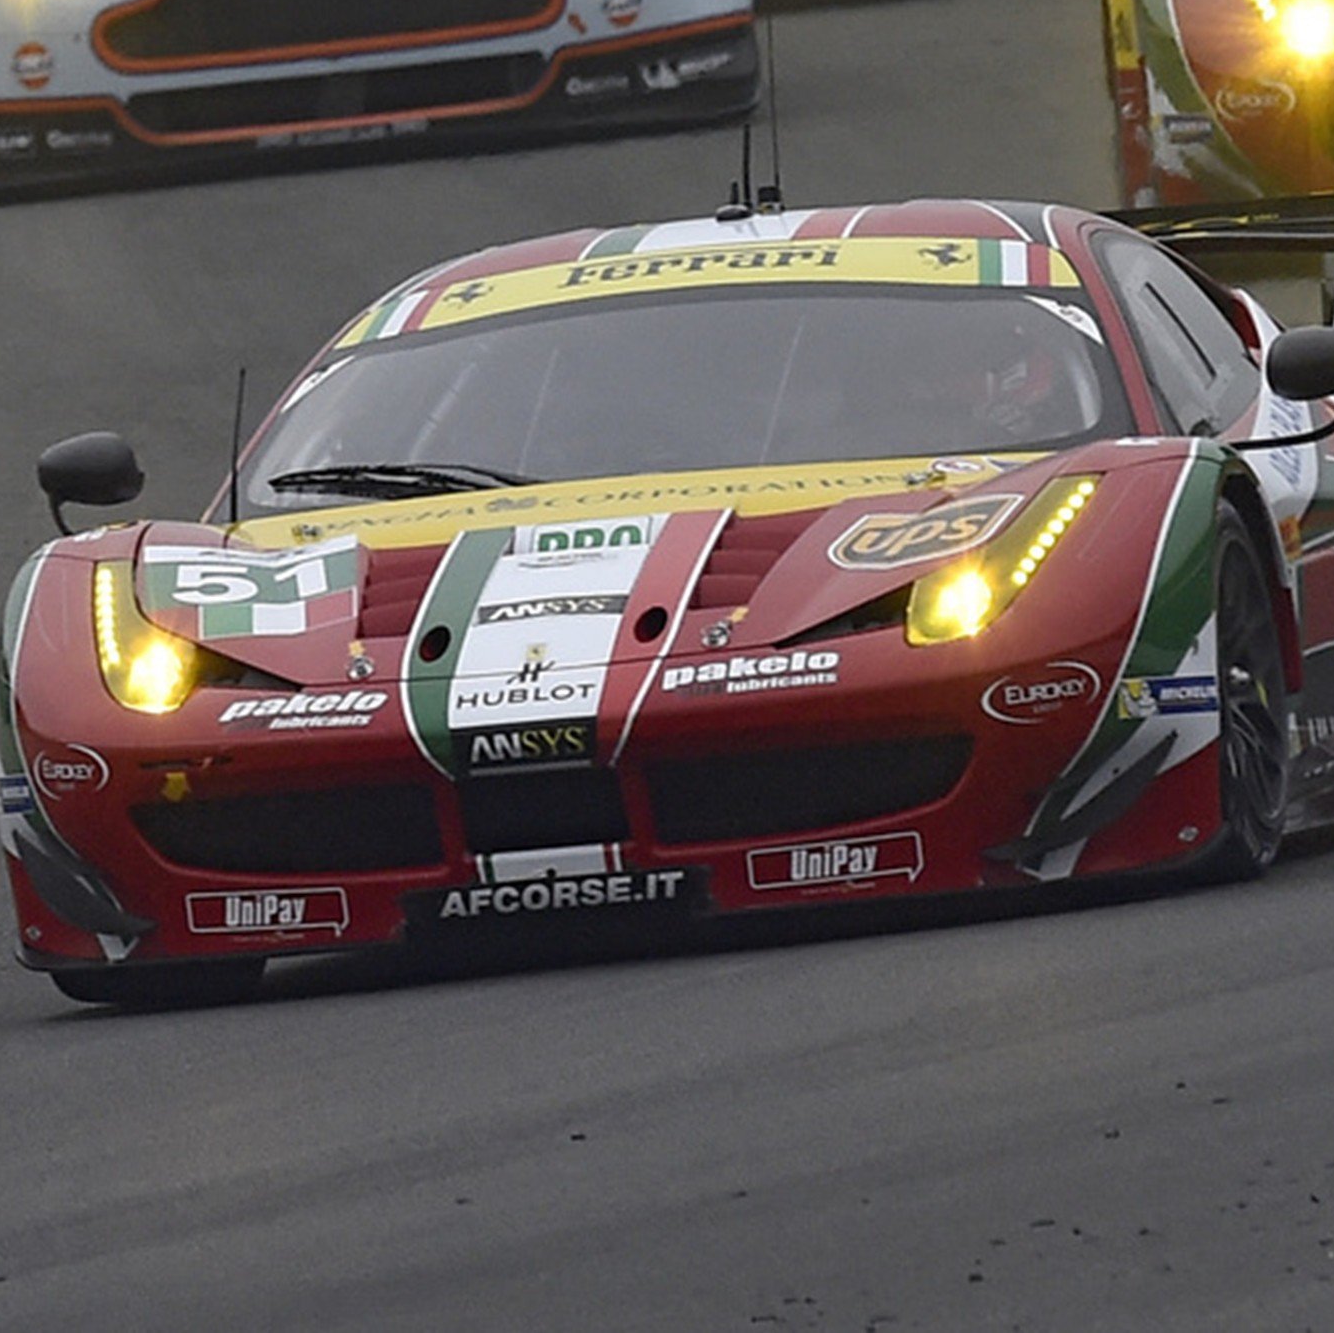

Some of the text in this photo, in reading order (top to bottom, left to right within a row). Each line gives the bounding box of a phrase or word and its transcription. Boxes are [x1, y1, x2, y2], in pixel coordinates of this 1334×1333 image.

[556, 244, 841, 290] Ferrari
[850, 513, 989, 558] ups
[171, 557, 329, 605] 51
[487, 597, 611, 620] ANSYS
[661, 650, 841, 692] pakelo
[726, 669, 839, 694] lubricants
[218, 689, 389, 723] pakelo
[455, 682, 598, 711] HUBLOT
[1002, 676, 1089, 707] EUROKEY
[269, 713, 373, 731] lubricants
[470, 724, 589, 763] ANSYS
[789, 843, 879, 882] UniPay
[224, 894, 306, 928] UniPay
[439, 870, 686, 919] AFCORSE.IT
